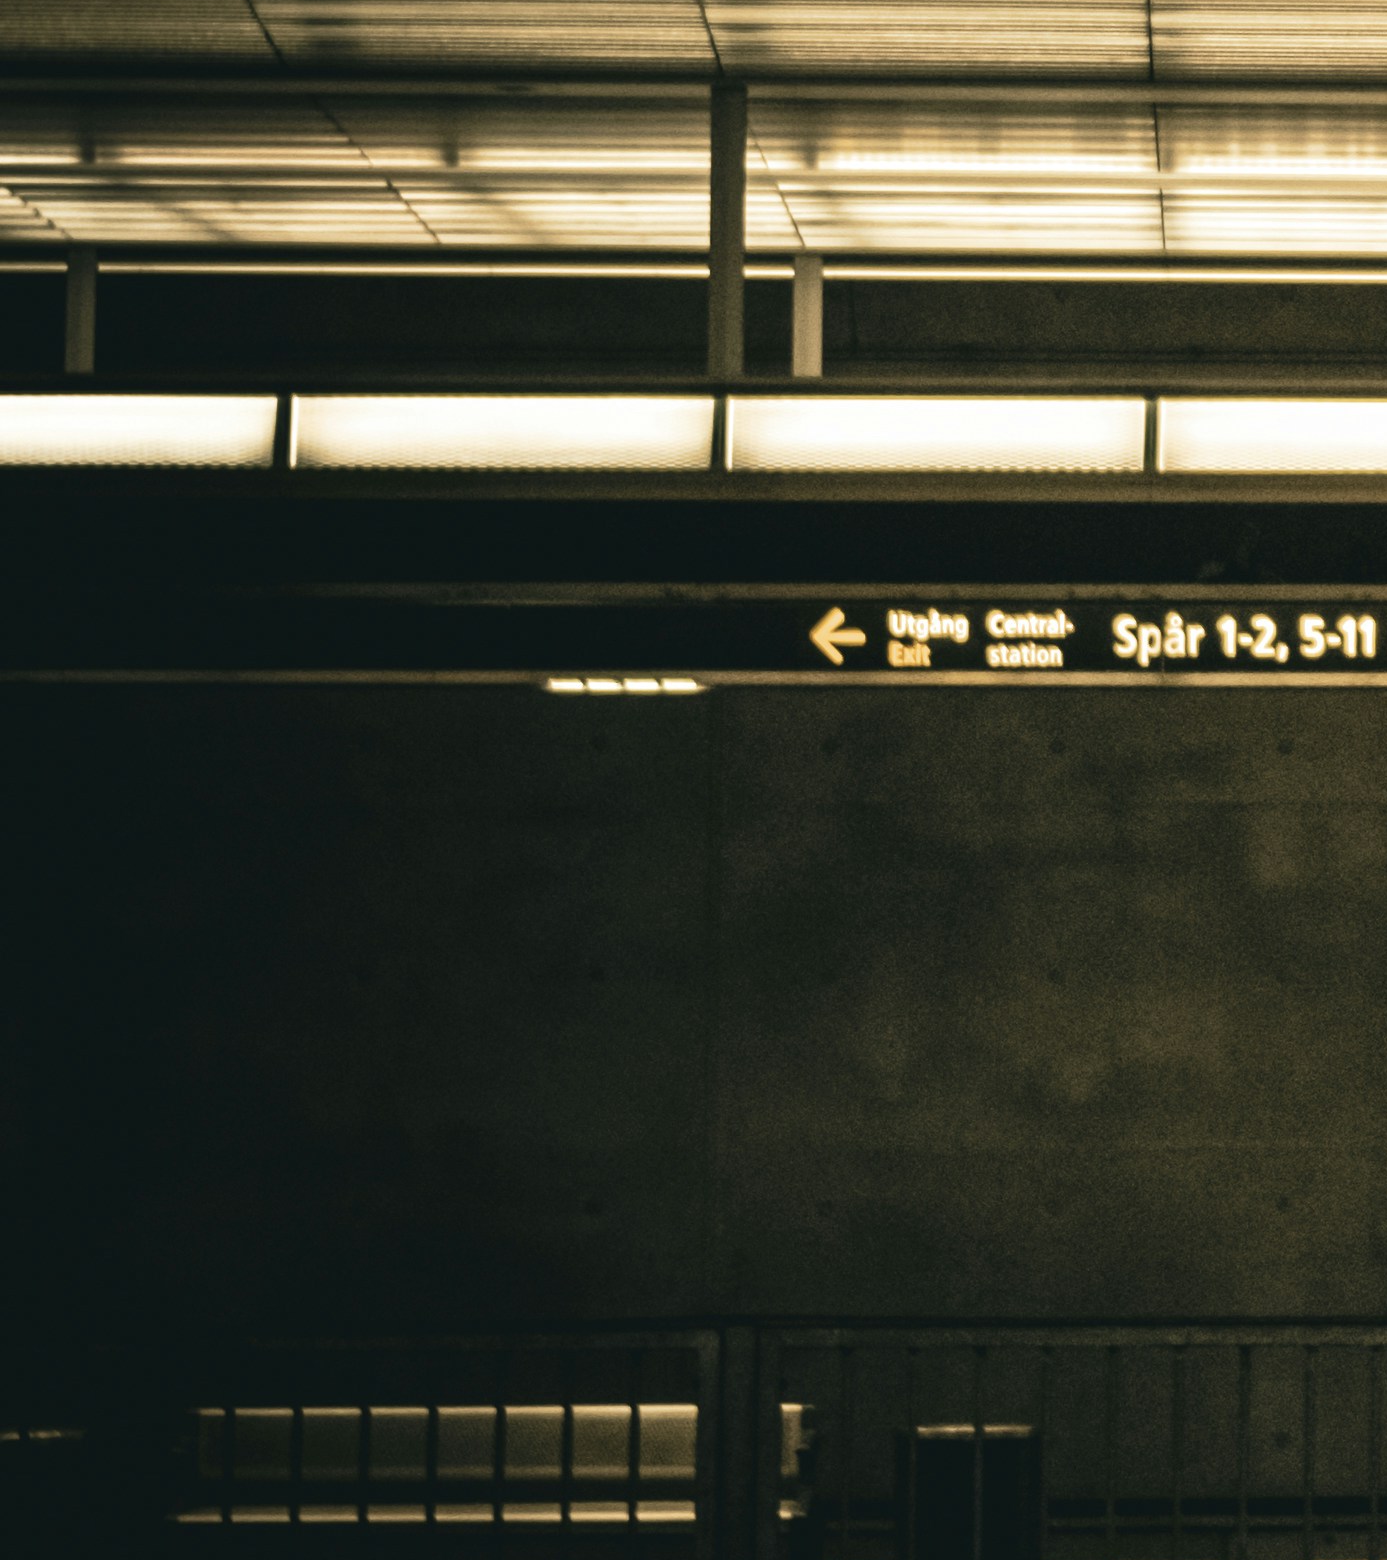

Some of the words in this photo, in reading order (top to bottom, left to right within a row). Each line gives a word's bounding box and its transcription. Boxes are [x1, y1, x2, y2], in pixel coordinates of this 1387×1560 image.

[888, 608, 969, 643] Utgång
[986, 608, 1074, 638] Central-
[888, 640, 931, 667] Exit
[986, 641, 1063, 667] station
[1112, 611, 1205, 667] Spår
[1216, 613, 1289, 663] 1-2,
[1298, 613, 1376, 658] 5-11
